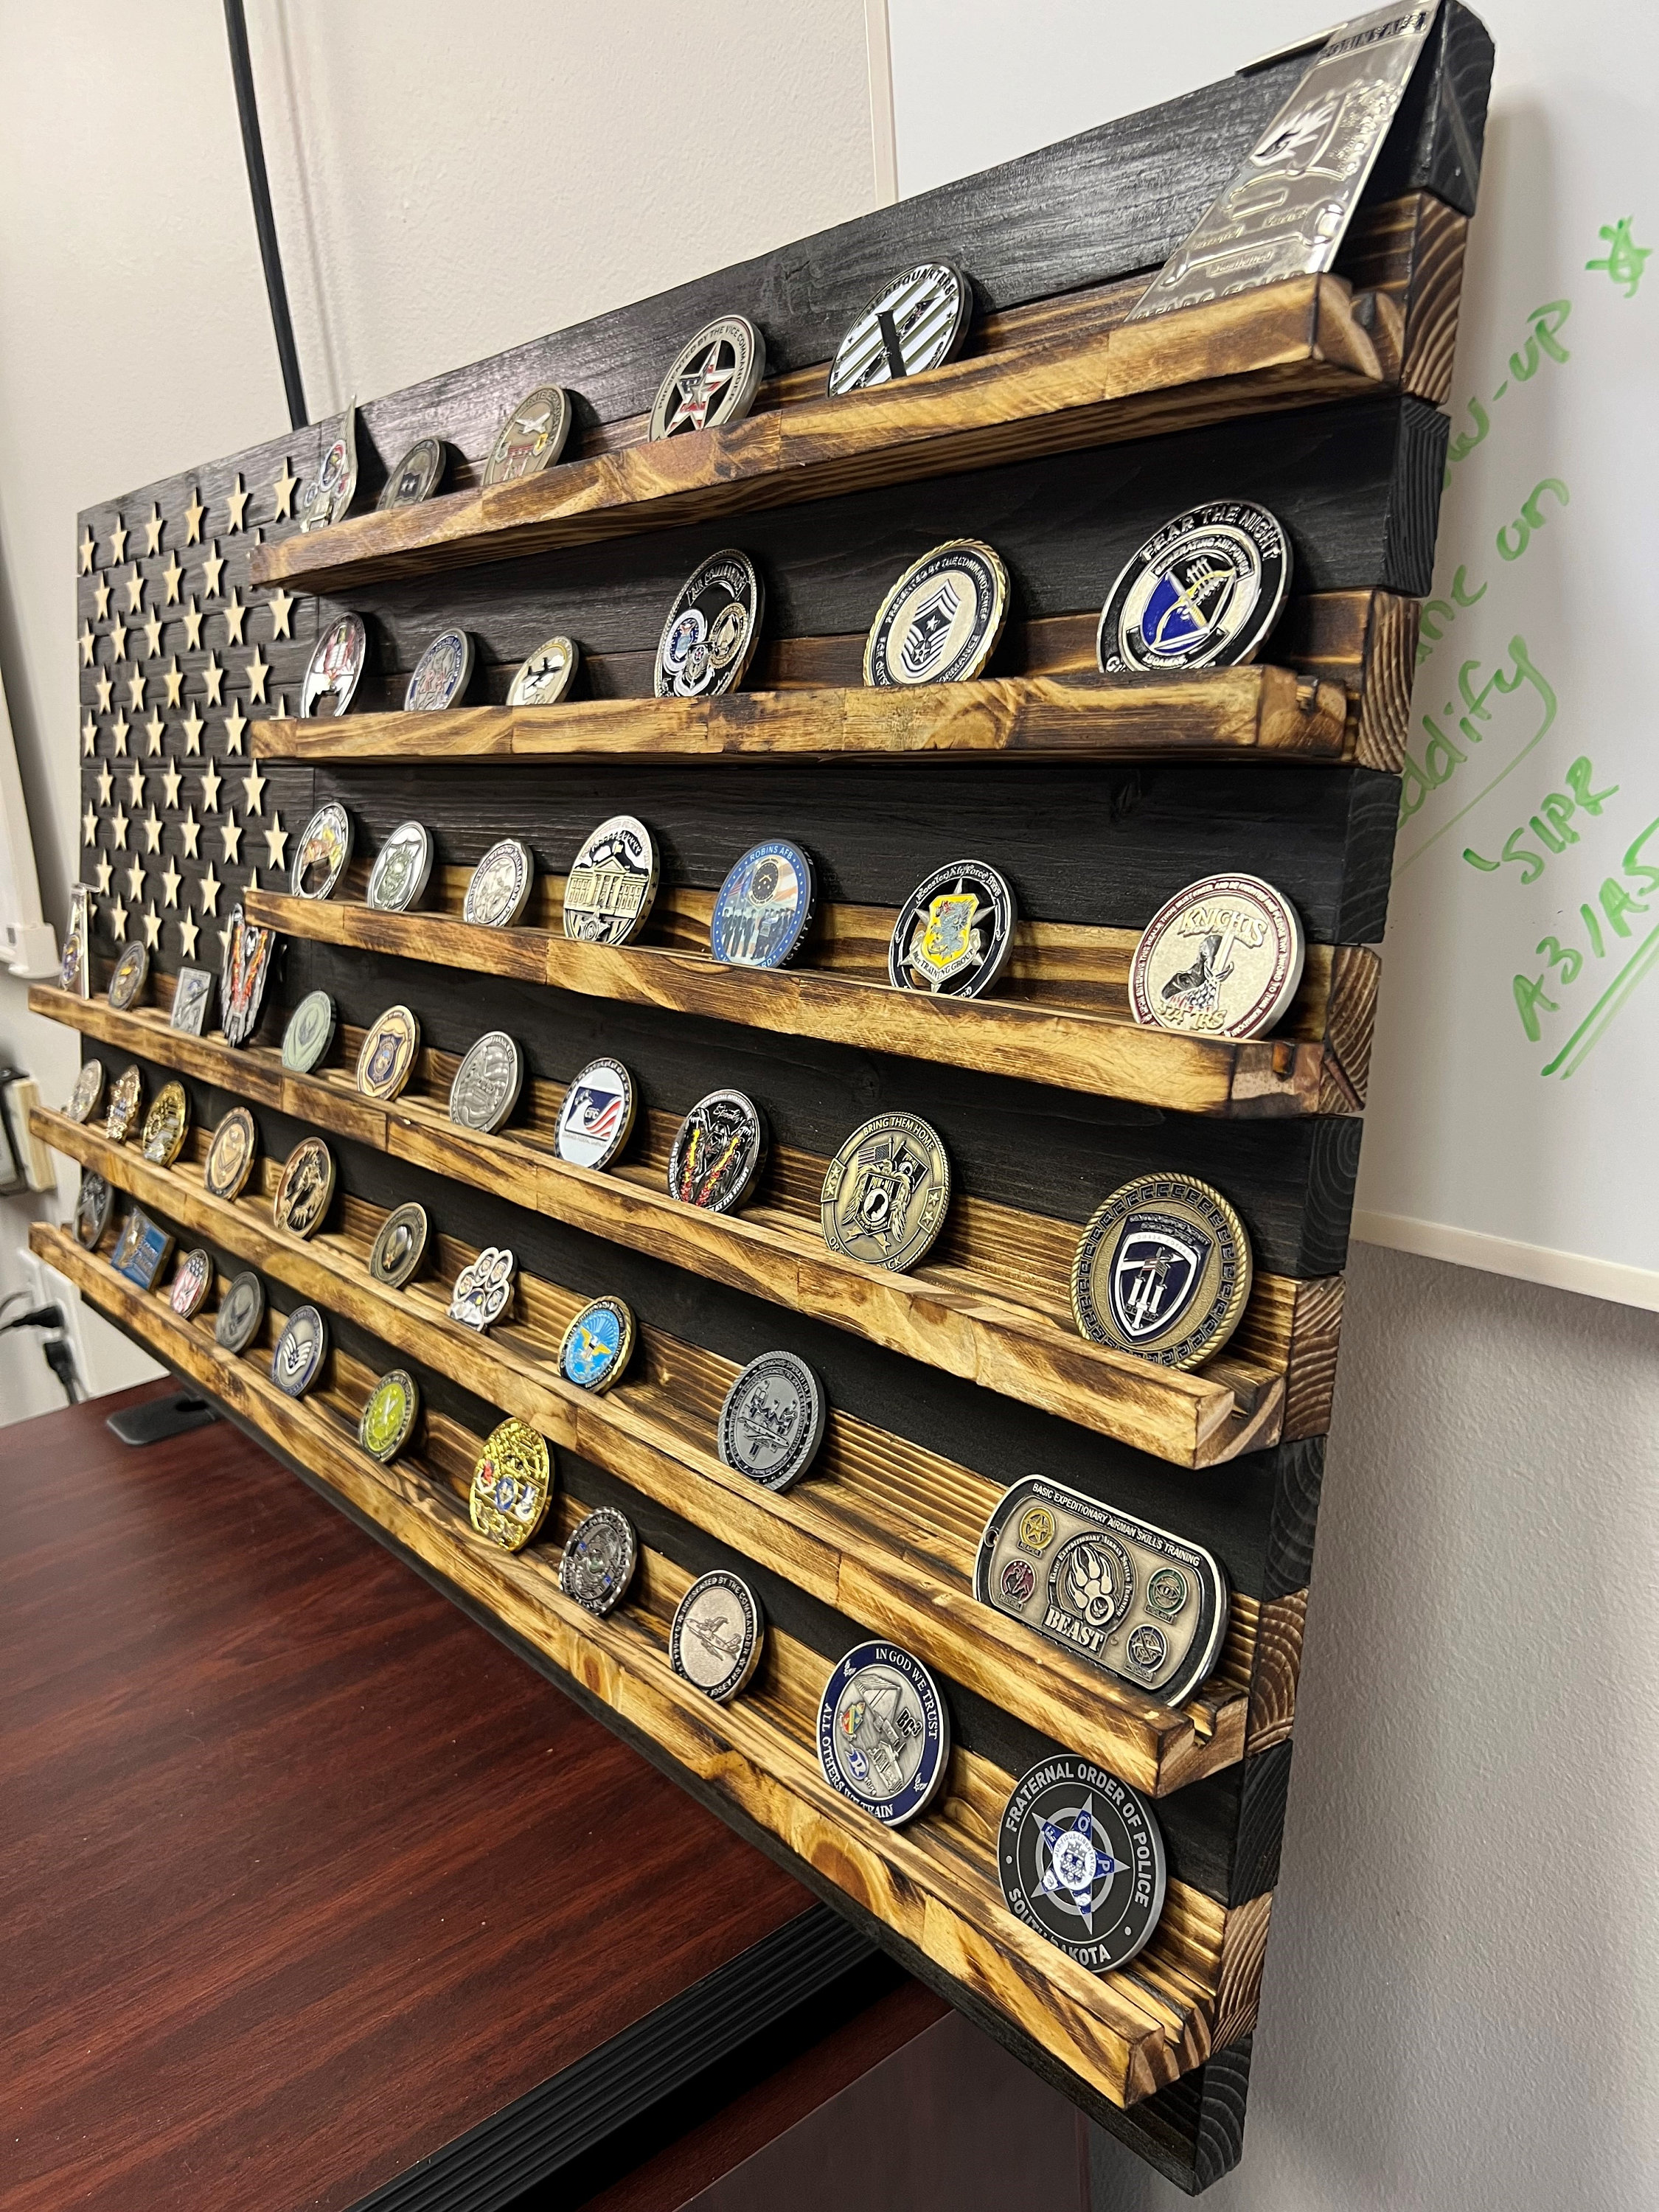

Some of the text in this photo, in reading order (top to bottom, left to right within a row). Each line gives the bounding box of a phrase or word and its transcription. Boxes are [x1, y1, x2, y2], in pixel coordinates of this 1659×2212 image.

[866, 268, 956, 314] HEADQUARTERS
[658, 325, 745, 408] PRESENTED BY THE VICE COMMANDER
[1141, 504, 1282, 563] FEAR THE NIGHT
[1155, 537, 1215, 575] GENERATING
[885, 556, 990, 623] PRESENTED BY THE COMMAND CHIEF
[749, 845, 794, 862] ROBINS AFB
[1145, 922, 1164, 947] REALM
[1159, 906, 1177, 923] THOU
[1178, 907, 1268, 947] KNIGHTS
[920, 959, 950, 980] TRAINING
[950, 948, 974, 970] GROUP
[863, 1116, 936, 1152] BRING THEM HOME
[732, 1166, 750, 1195] FINEST
[1032, 1482, 1201, 1567] BASIC EXPEDITIONARY AIRMAN SKILLS TRAINING
[681, 1576, 754, 1655] PRESENTED BY THE COMMANDER
[1045, 1607, 1105, 1652] BEAST
[875, 1648, 938, 1740] IN GOD WE TRUST
[822, 1703, 832, 1733] ALL
[822, 1736, 846, 1793] OTHERS
[860, 1803, 894, 1818] TRAIN
[1005, 1762, 1152, 1908] FRATERNAL ORDER OF POLICE
[1008, 1888, 1051, 1941] SOUT
